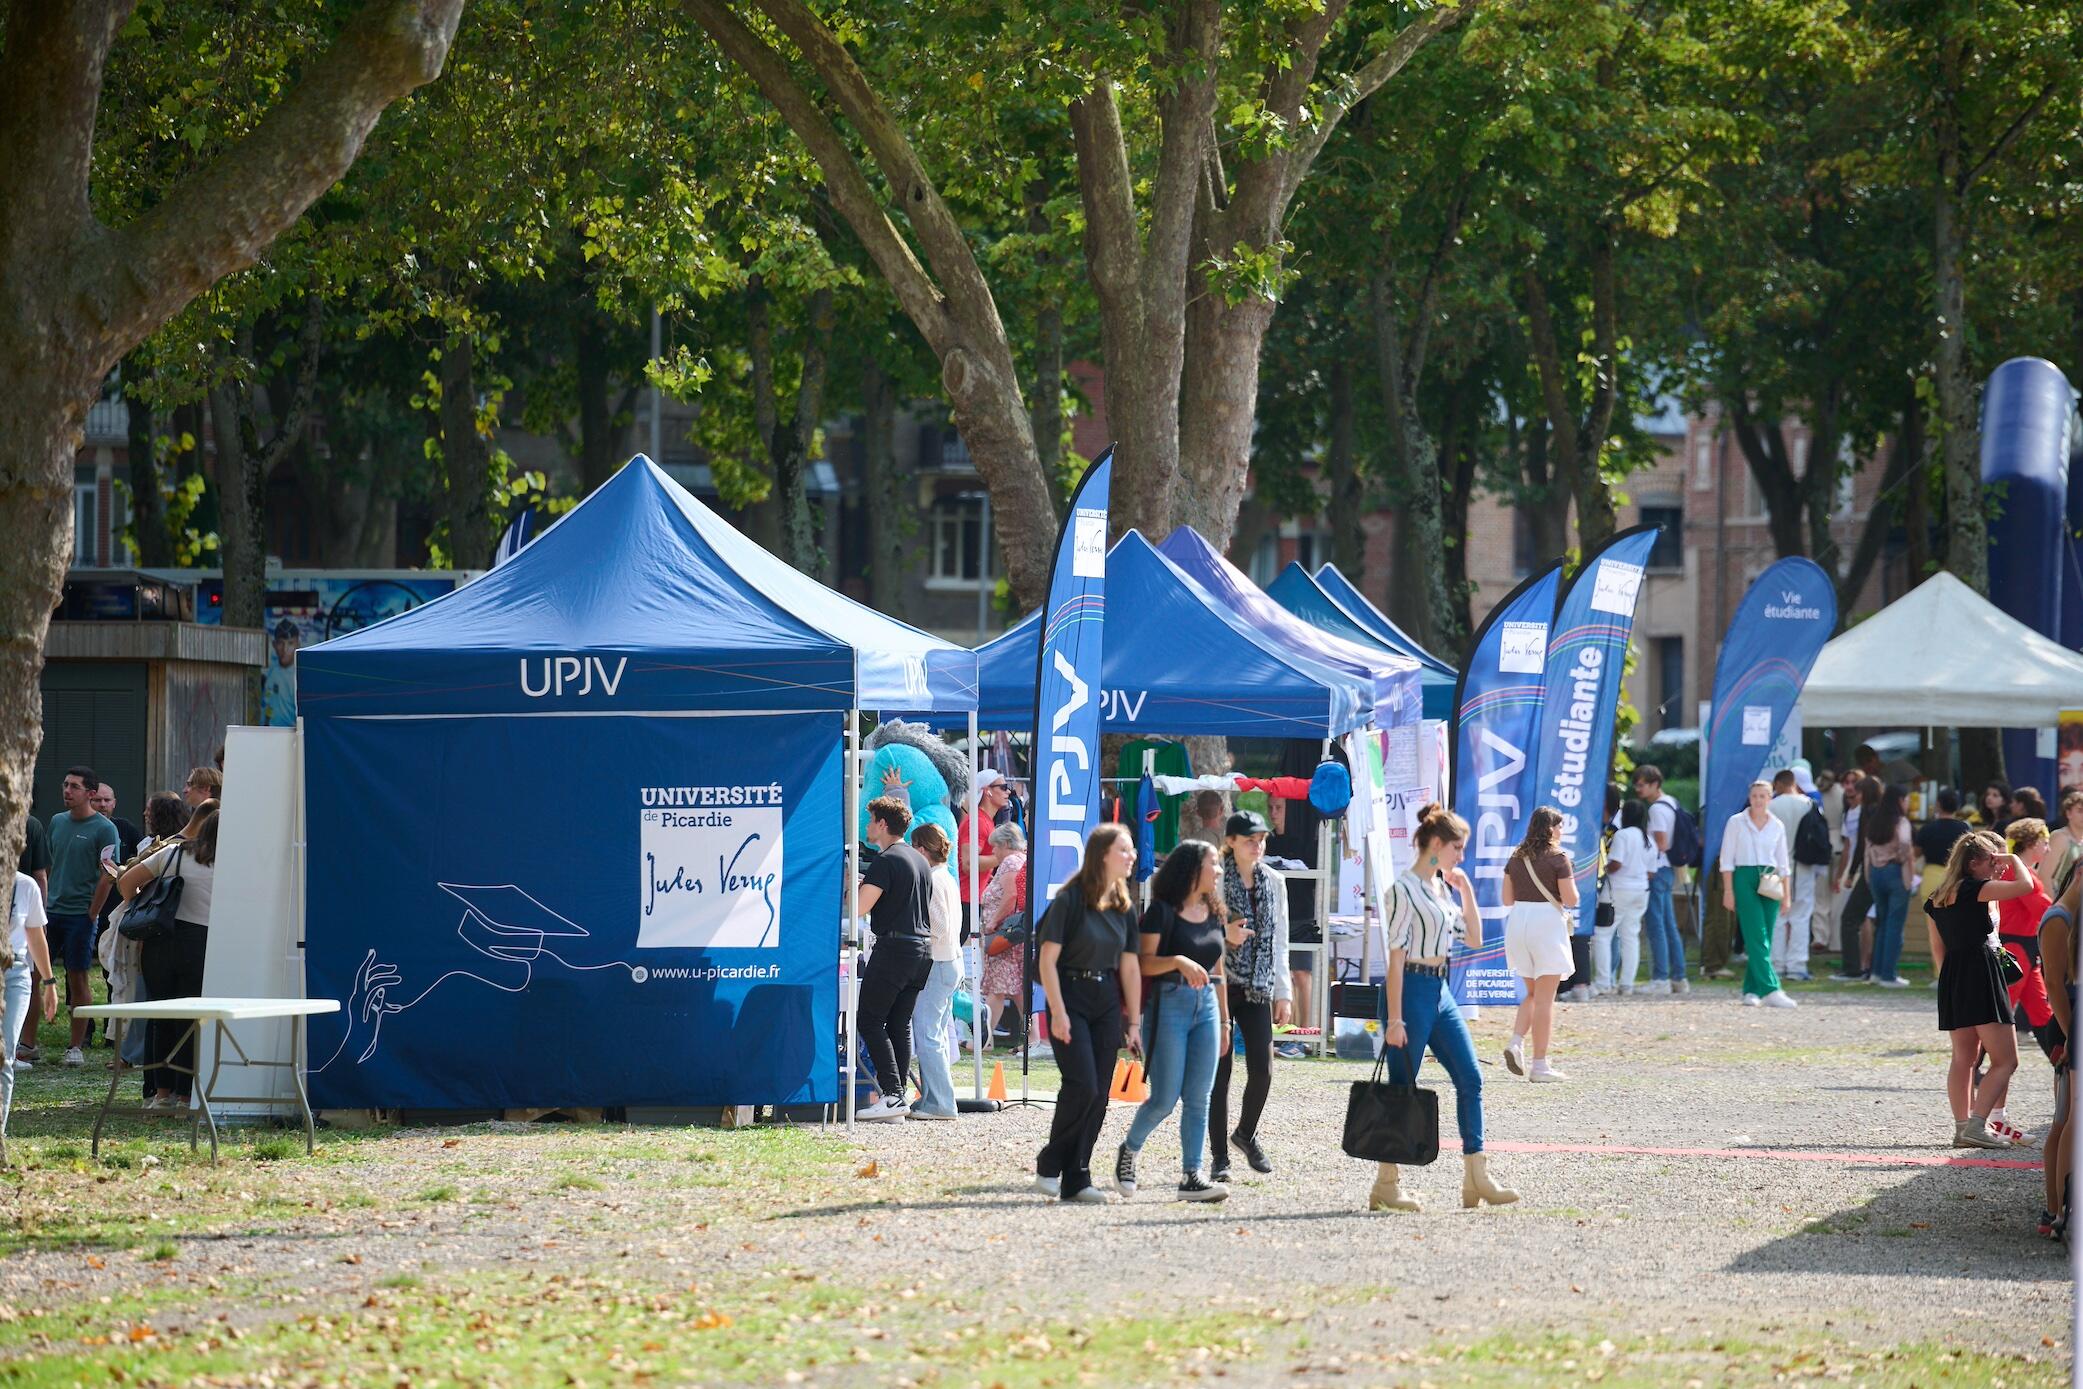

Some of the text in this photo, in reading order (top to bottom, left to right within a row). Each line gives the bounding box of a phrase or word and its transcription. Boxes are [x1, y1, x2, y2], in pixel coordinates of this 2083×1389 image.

[1781, 590, 1802, 605] Vie
[1764, 603, 1820, 620] étudiante
[520, 656, 628, 697] UPJV
[1100, 689, 1148, 721] PJV
[1550, 646, 1604, 808] étudiante
[640, 781, 783, 806] UNIVERSITÉ
[643, 810, 733, 828] de Picardie
[645, 833, 776, 947] Jules Verne
[652, 964, 781, 981] www.u-picardie.fr
[1465, 980, 1516, 988] DE PICARDIE
[1466, 991, 1516, 999] JULES VERNE
